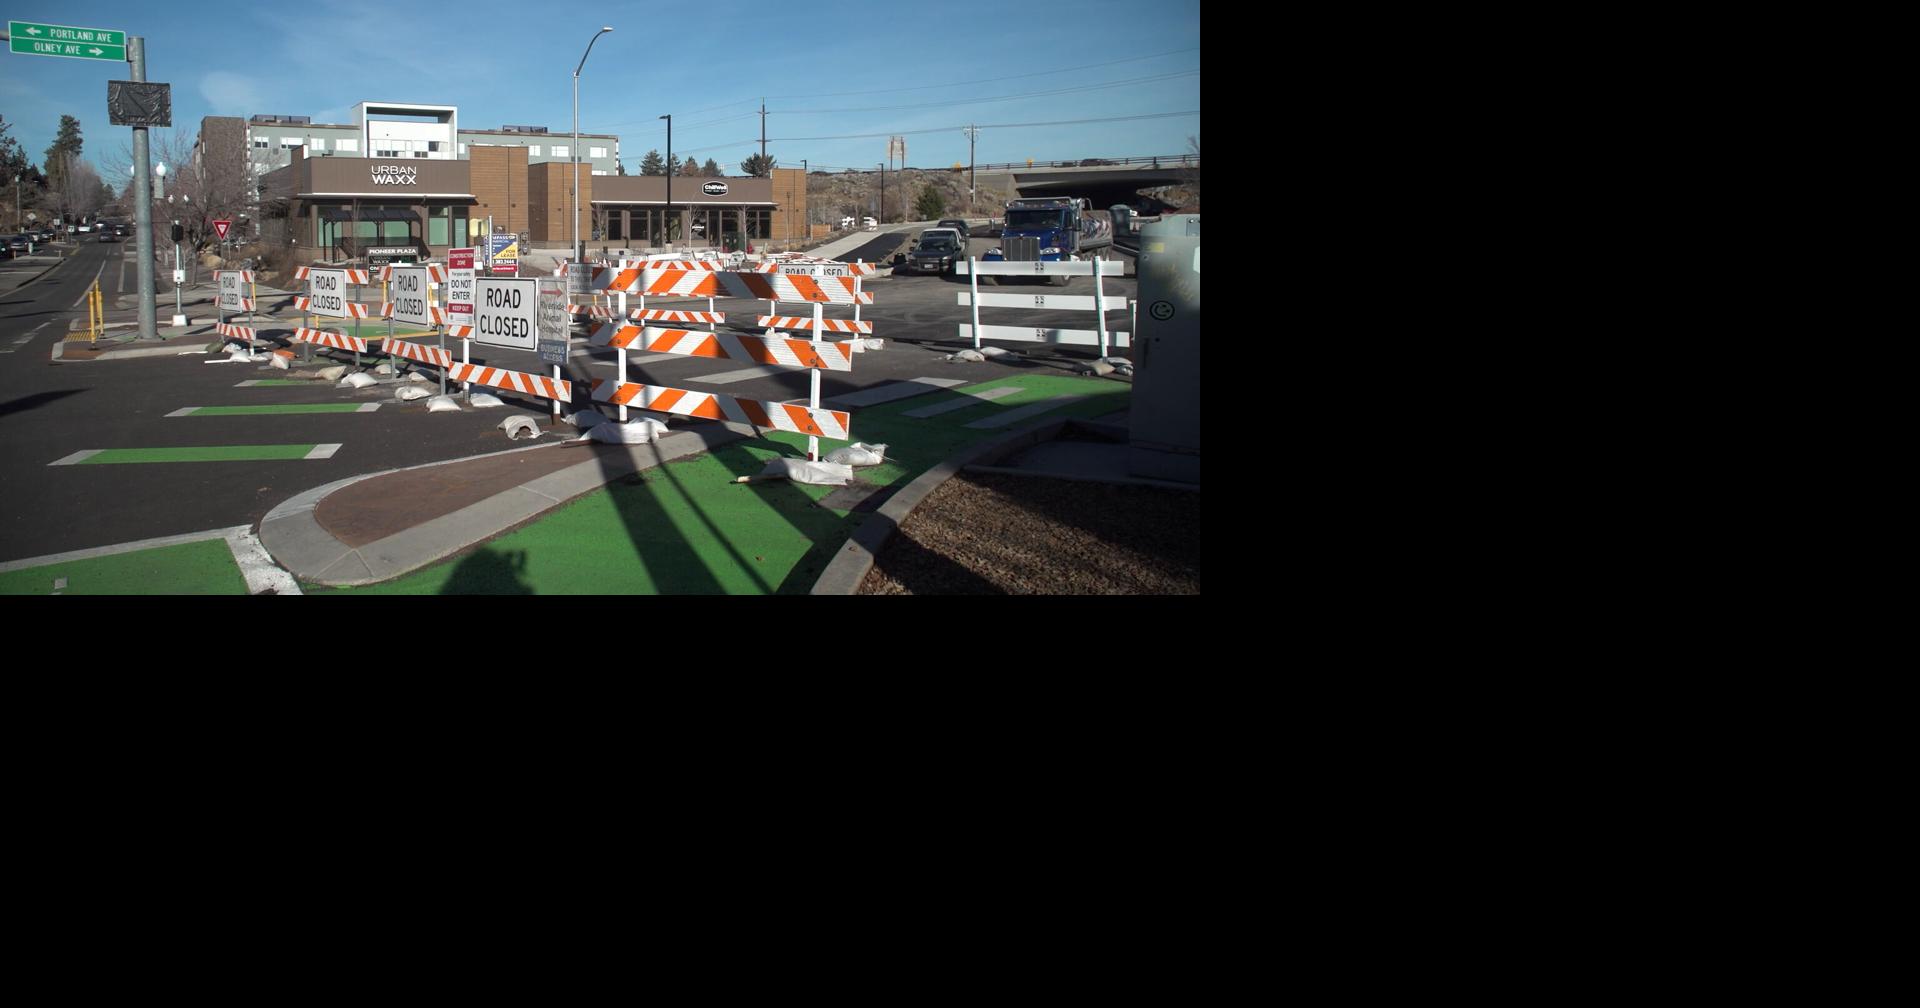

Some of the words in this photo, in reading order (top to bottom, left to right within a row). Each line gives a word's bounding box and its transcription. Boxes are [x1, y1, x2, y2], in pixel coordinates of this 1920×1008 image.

[50, 28, 94, 41] PORTLAND
[97, 33, 112, 42] AVE
[34, 42, 61, 53] OLNEY
[65, 45, 81, 54] AVE
[371, 165, 417, 174] URBAN
[371, 174, 417, 185] WAXX
[223, 276, 236, 288] ROAD
[315, 275, 337, 291] ROAD
[398, 275, 418, 292] ROAD
[451, 279, 460, 288] DO
[460, 279, 472, 289] NOT
[221, 293, 238, 306] CLOSED
[452, 291, 471, 300] ENTER
[486, 287, 521, 309] ROAD
[312, 294, 341, 311] CLOSED
[396, 297, 423, 316] CLOSED
[480, 314, 529, 338] CLOSED
